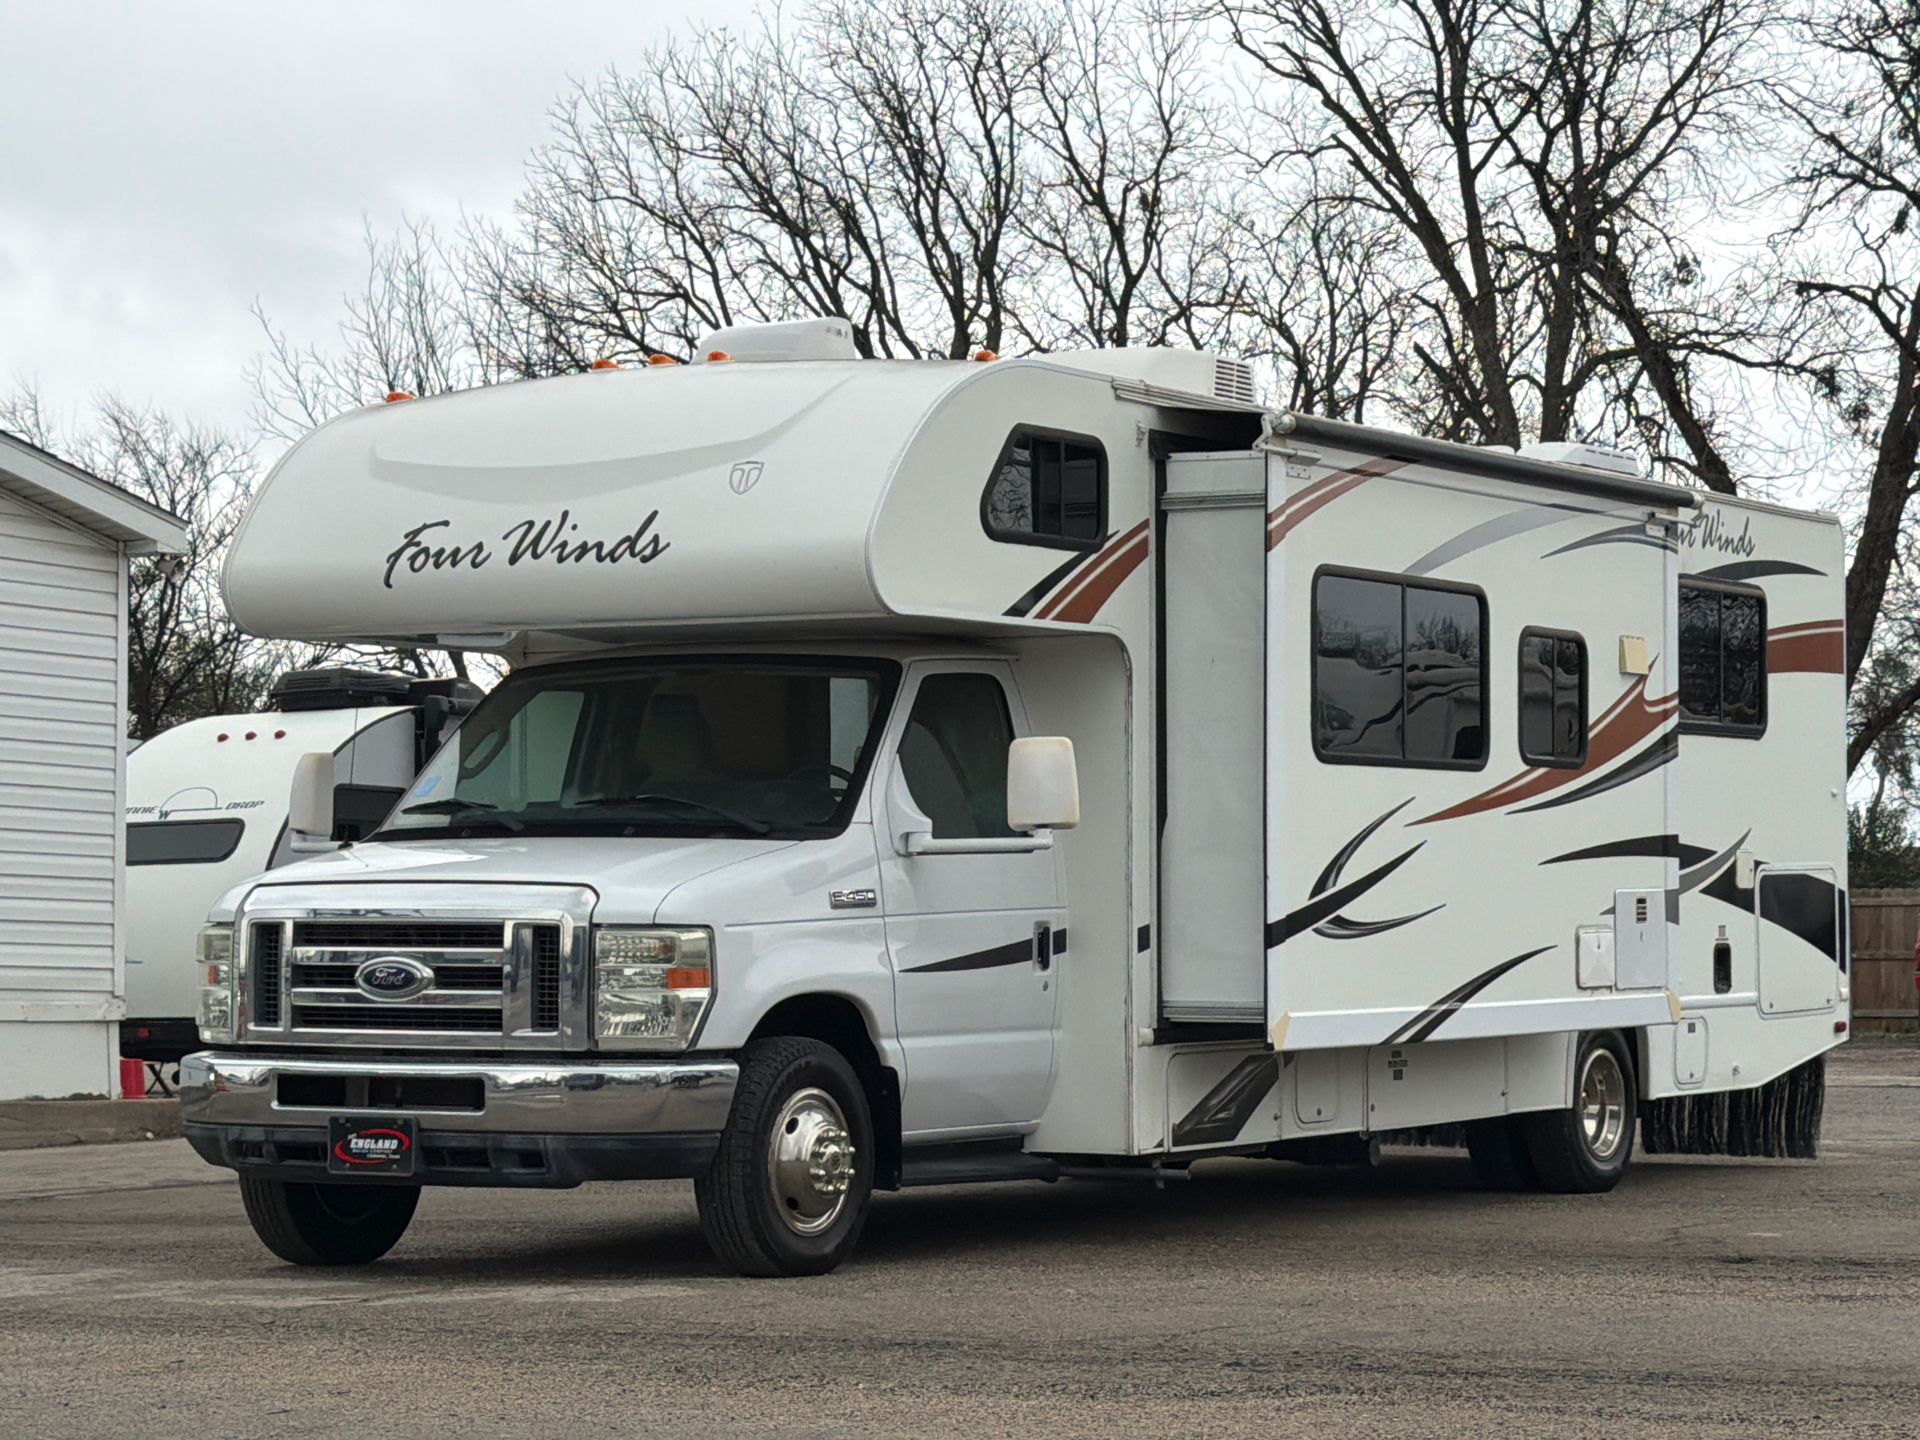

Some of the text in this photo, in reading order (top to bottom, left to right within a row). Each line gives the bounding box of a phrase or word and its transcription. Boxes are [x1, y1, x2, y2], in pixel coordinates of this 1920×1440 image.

[1697, 508, 1756, 558] Winds
[384, 510, 671, 589] Four Winds
[225, 800, 265, 810] DROP
[371, 967, 406, 985] Ford
[349, 1138, 399, 1150] ENGLAND
